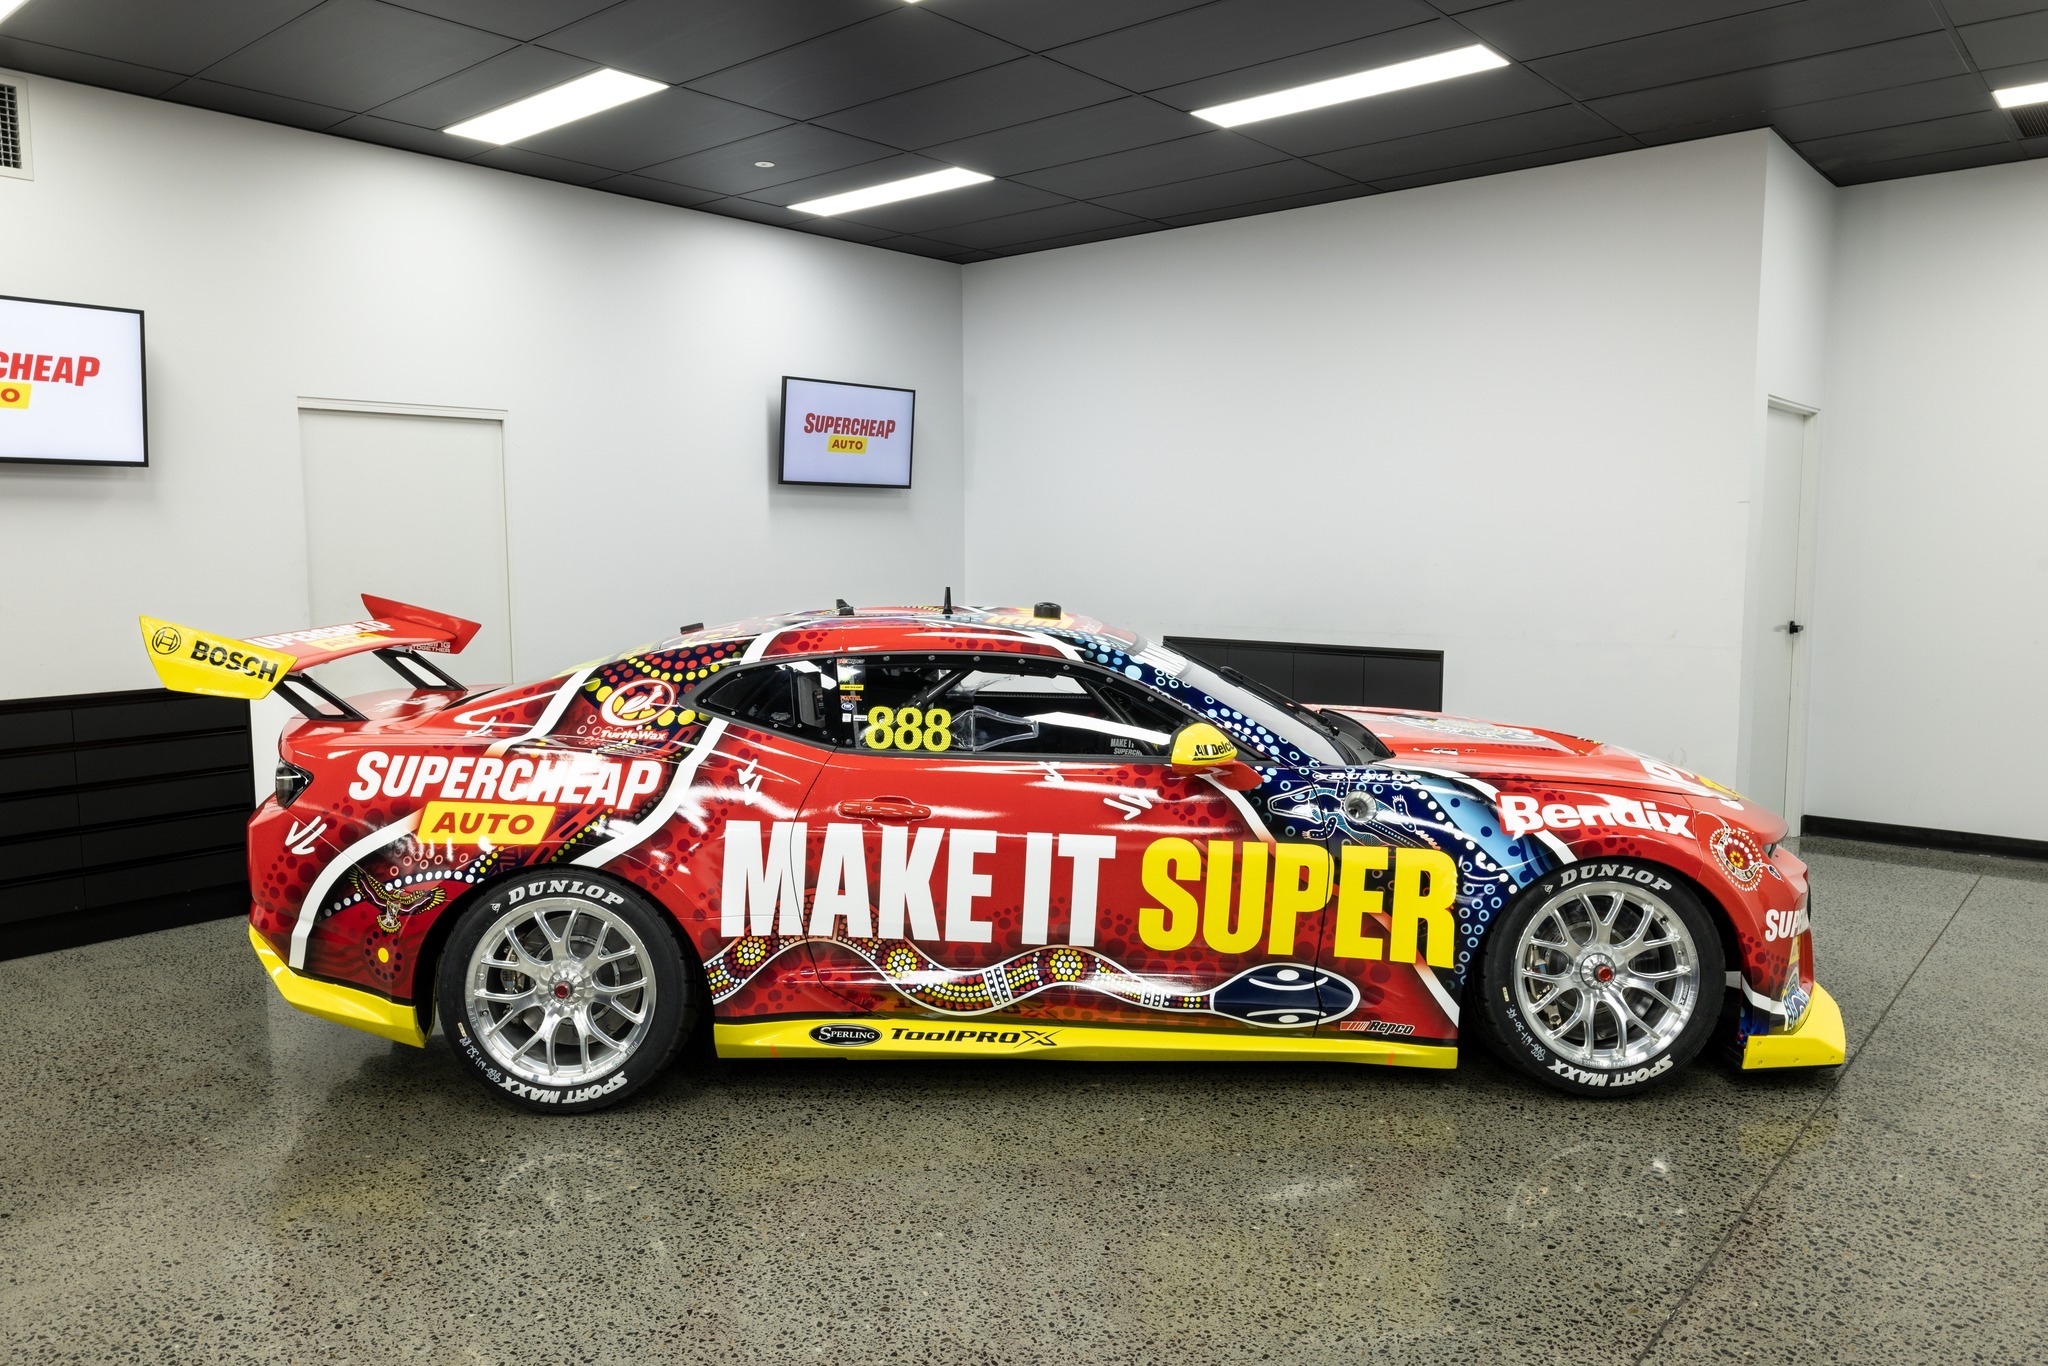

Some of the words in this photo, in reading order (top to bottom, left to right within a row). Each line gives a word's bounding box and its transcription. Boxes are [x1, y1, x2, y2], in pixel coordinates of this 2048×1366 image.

[804, 412, 896, 439] SUPERCHEAP
[831, 439, 863, 450] AUTO
[245, 620, 395, 649] UPERCHEAP
[190, 640, 278, 682] BOSCH
[866, 706, 952, 752] 888
[1110, 738, 1128, 748] MAKE
[348, 751, 663, 810] SUPERCHEAP
[431, 812, 535, 835] AUTO
[1500, 795, 1696, 841] Bendix
[508, 879, 625, 905] DUNLOP
[1560, 864, 1673, 892] DUNLOP
[721, 820, 1000, 942] MAKE
[1021, 832, 1117, 947] IT
[1139, 837, 1458, 968] SUPER
[818, 1026, 876, 1041] SPERLING
[1366, 1020, 1415, 1035] Repco
[1547, 1058, 1609, 1087] MAXX
[1609, 1053, 1674, 1087] SPORT
[498, 1076, 561, 1104] MAXX
[562, 1070, 628, 1104] SPORT
